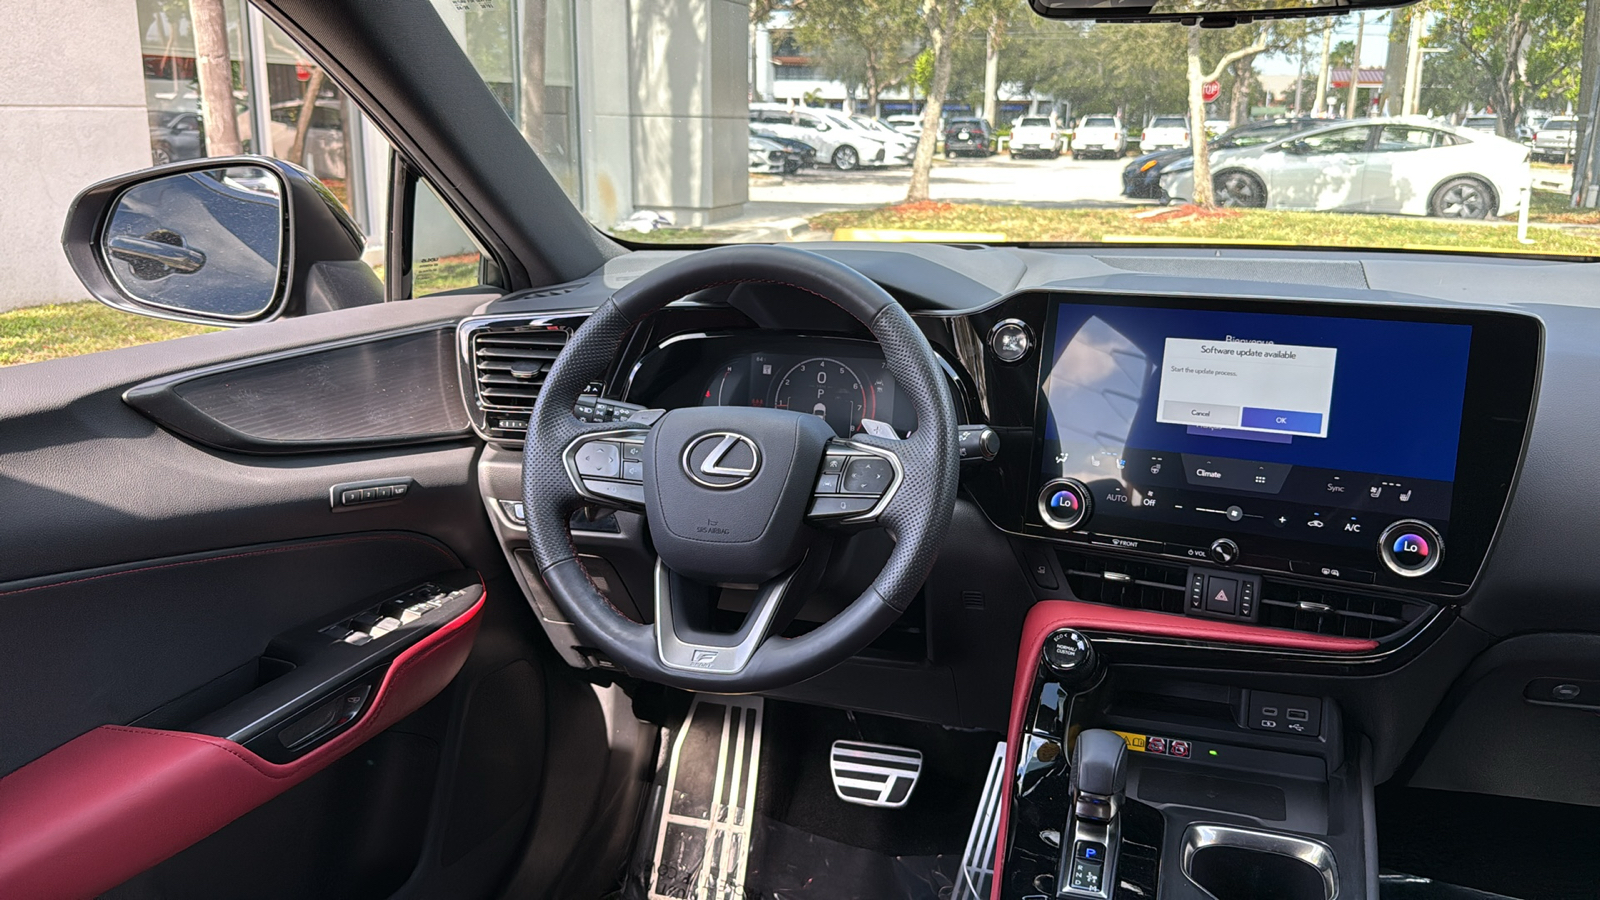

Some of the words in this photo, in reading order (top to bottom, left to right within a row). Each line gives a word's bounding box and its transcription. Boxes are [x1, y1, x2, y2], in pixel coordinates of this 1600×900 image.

[1200, 345, 1234, 356] Software
[1236, 348, 1263, 358] update
[1263, 350, 1296, 360] available
[1171, 365, 1184, 373] Start
[1184, 366, 1195, 374] the
[1194, 367, 1215, 375] update
[817, 388, 825, 399] P
[1191, 409, 1211, 418] Cancel
[1275, 416, 1288, 425] OK
[1196, 468, 1222, 479] Climate
[1326, 483, 1345, 493] Sync
[1059, 496, 1072, 507] Lo
[1106, 493, 1128, 503] AUTO
[1143, 498, 1157, 507] Off
[1344, 523, 1362, 533] A/C
[1119, 540, 1139, 548] FRONT
[1403, 540, 1419, 553] Lo
[1086, 848, 1096, 858] P
